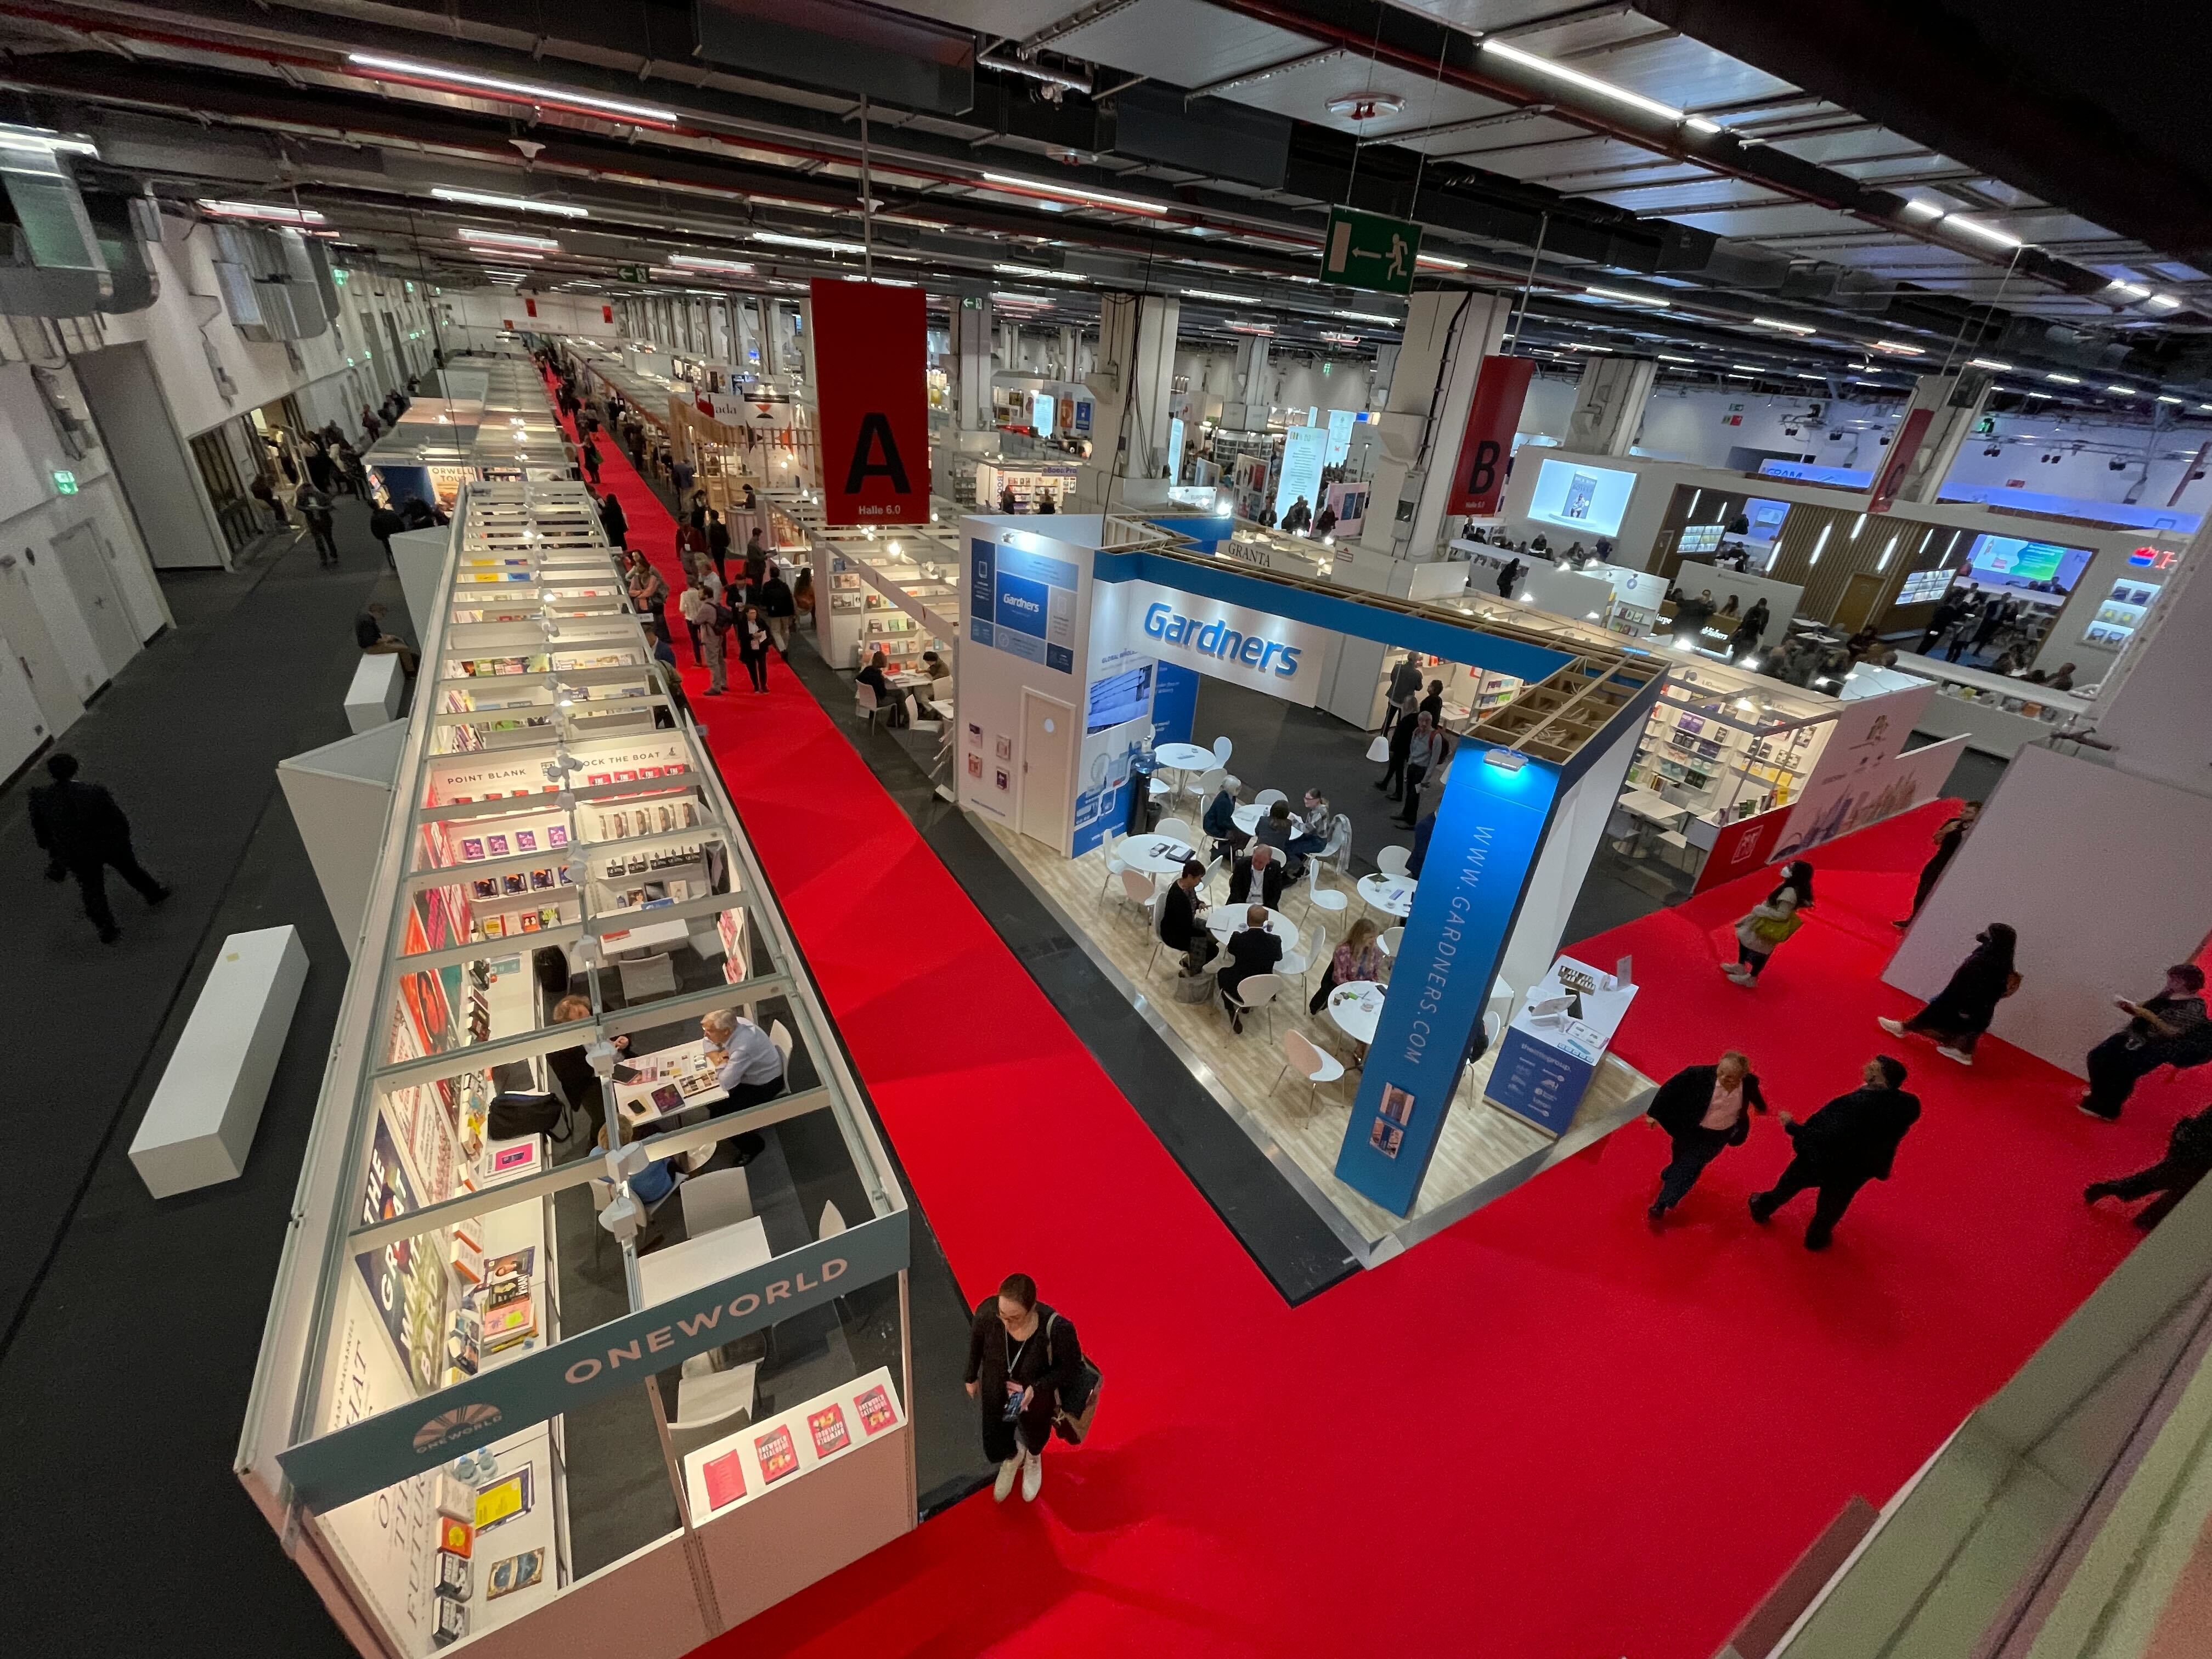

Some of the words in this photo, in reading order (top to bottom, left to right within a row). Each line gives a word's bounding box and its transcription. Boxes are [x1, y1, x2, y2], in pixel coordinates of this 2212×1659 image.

[844, 413, 912, 494] A
[1468, 441, 1500, 494] B
[859, 506, 883, 515] Halle
[886, 505, 901, 515] 6.0
[1228, 542, 1271, 567] GRANTA
[1003, 592, 1040, 613] Gardners
[1144, 601, 1302, 679] Gardners
[448, 774, 483, 785] POINT
[488, 768, 527, 780] BLANK
[583, 758, 606, 767] OCK
[608, 755, 629, 764] THE
[633, 752, 660, 761] BOAT
[1403, 825, 1496, 1065] WWW.GARDNERS.COM
[363, 1148, 385, 1224] THE
[564, 1258, 848, 1385] ONEWORLD
[858, 1394, 884, 1411] ONEWORLD
[416, 1414, 502, 1454] ONEWORLD
[758, 1435, 787, 1453] ONEWORLD
[407, 1477, 425, 1628] FUTUR
